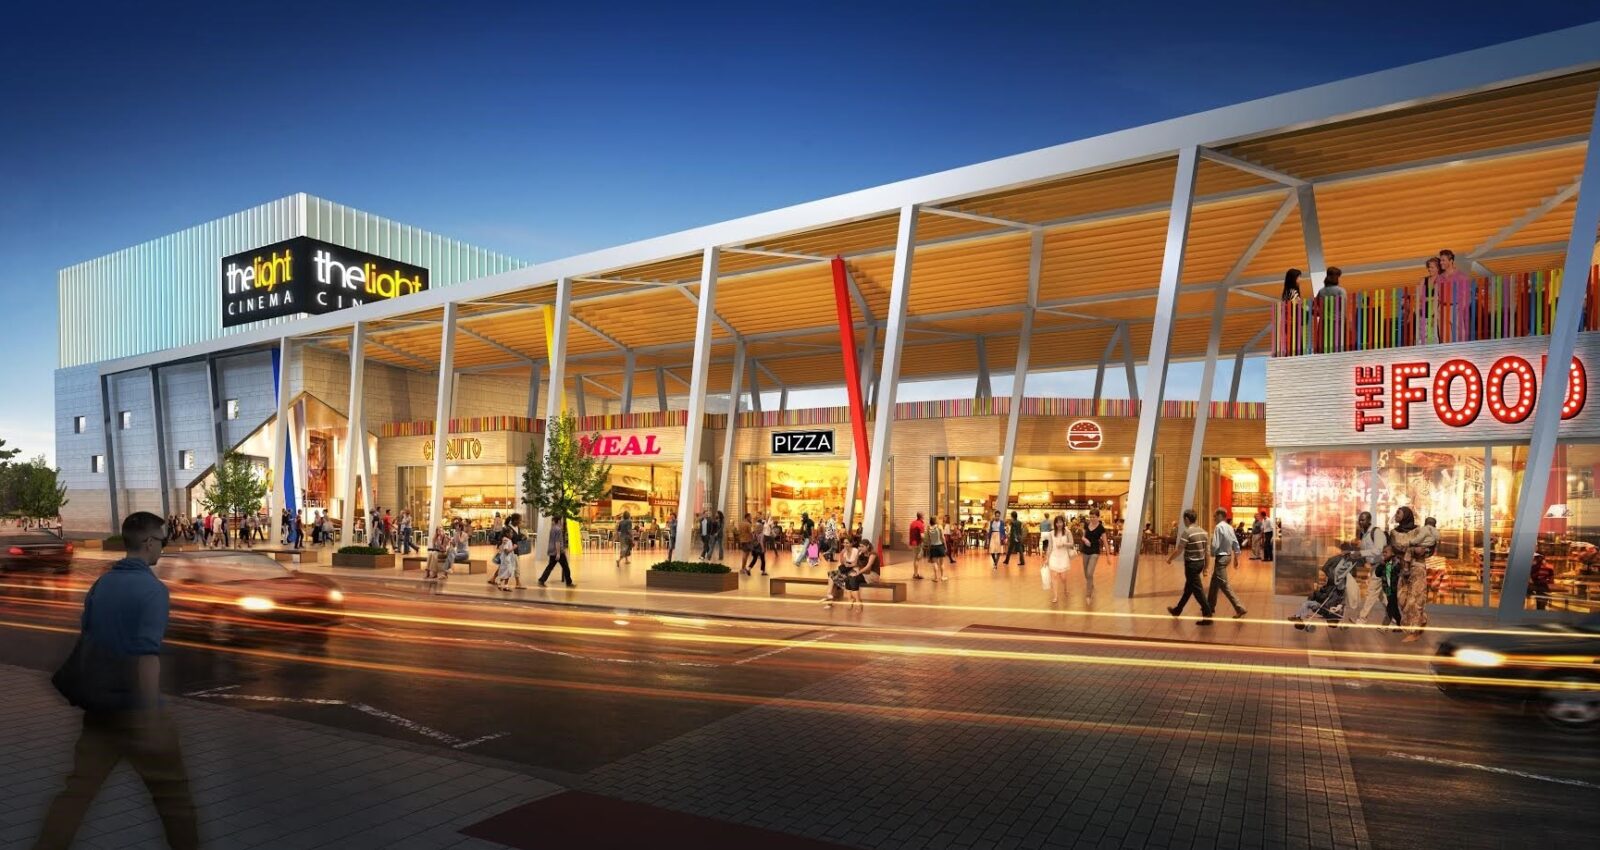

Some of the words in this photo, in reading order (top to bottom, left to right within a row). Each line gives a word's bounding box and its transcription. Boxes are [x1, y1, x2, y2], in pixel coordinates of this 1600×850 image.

[228, 290, 292, 316] CINEMA
[1355, 365, 1384, 432] THE
[578, 434, 661, 458] MEAL
[774, 434, 831, 452] PIZZA
